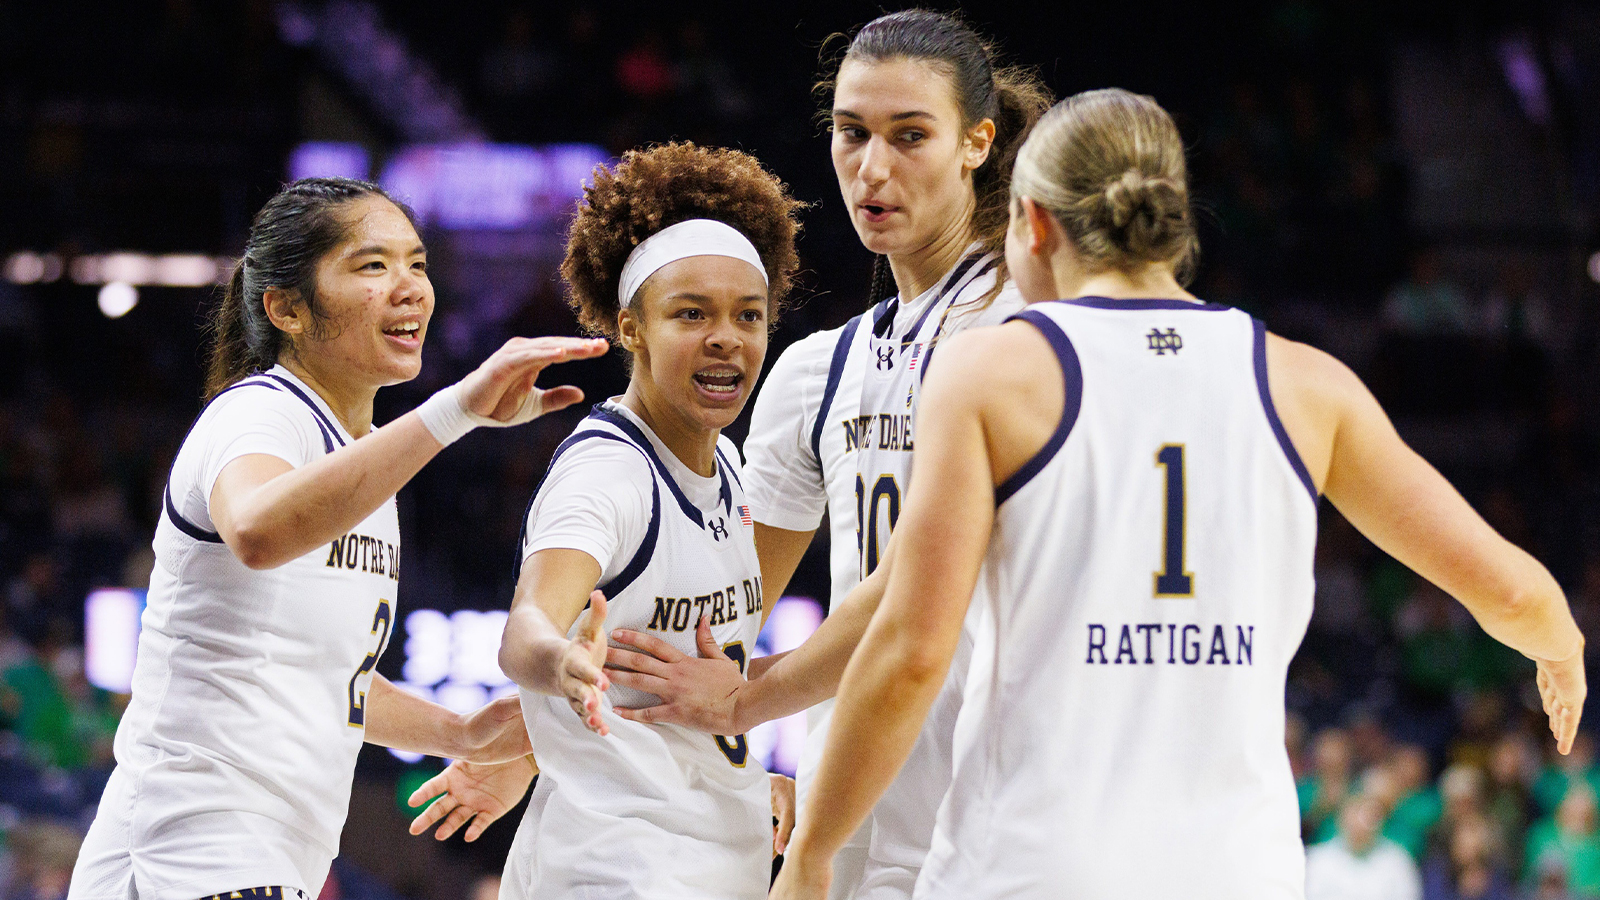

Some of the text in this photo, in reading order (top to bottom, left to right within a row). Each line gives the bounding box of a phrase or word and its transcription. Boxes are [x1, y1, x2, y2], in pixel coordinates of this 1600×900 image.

[1152, 442, 1195, 599] 1
[325, 533, 385, 576] NOTRE
[647, 576, 762, 632] NOTRE DA
[347, 598, 392, 729] 2
[1086, 624, 1254, 665] RATIGAN
